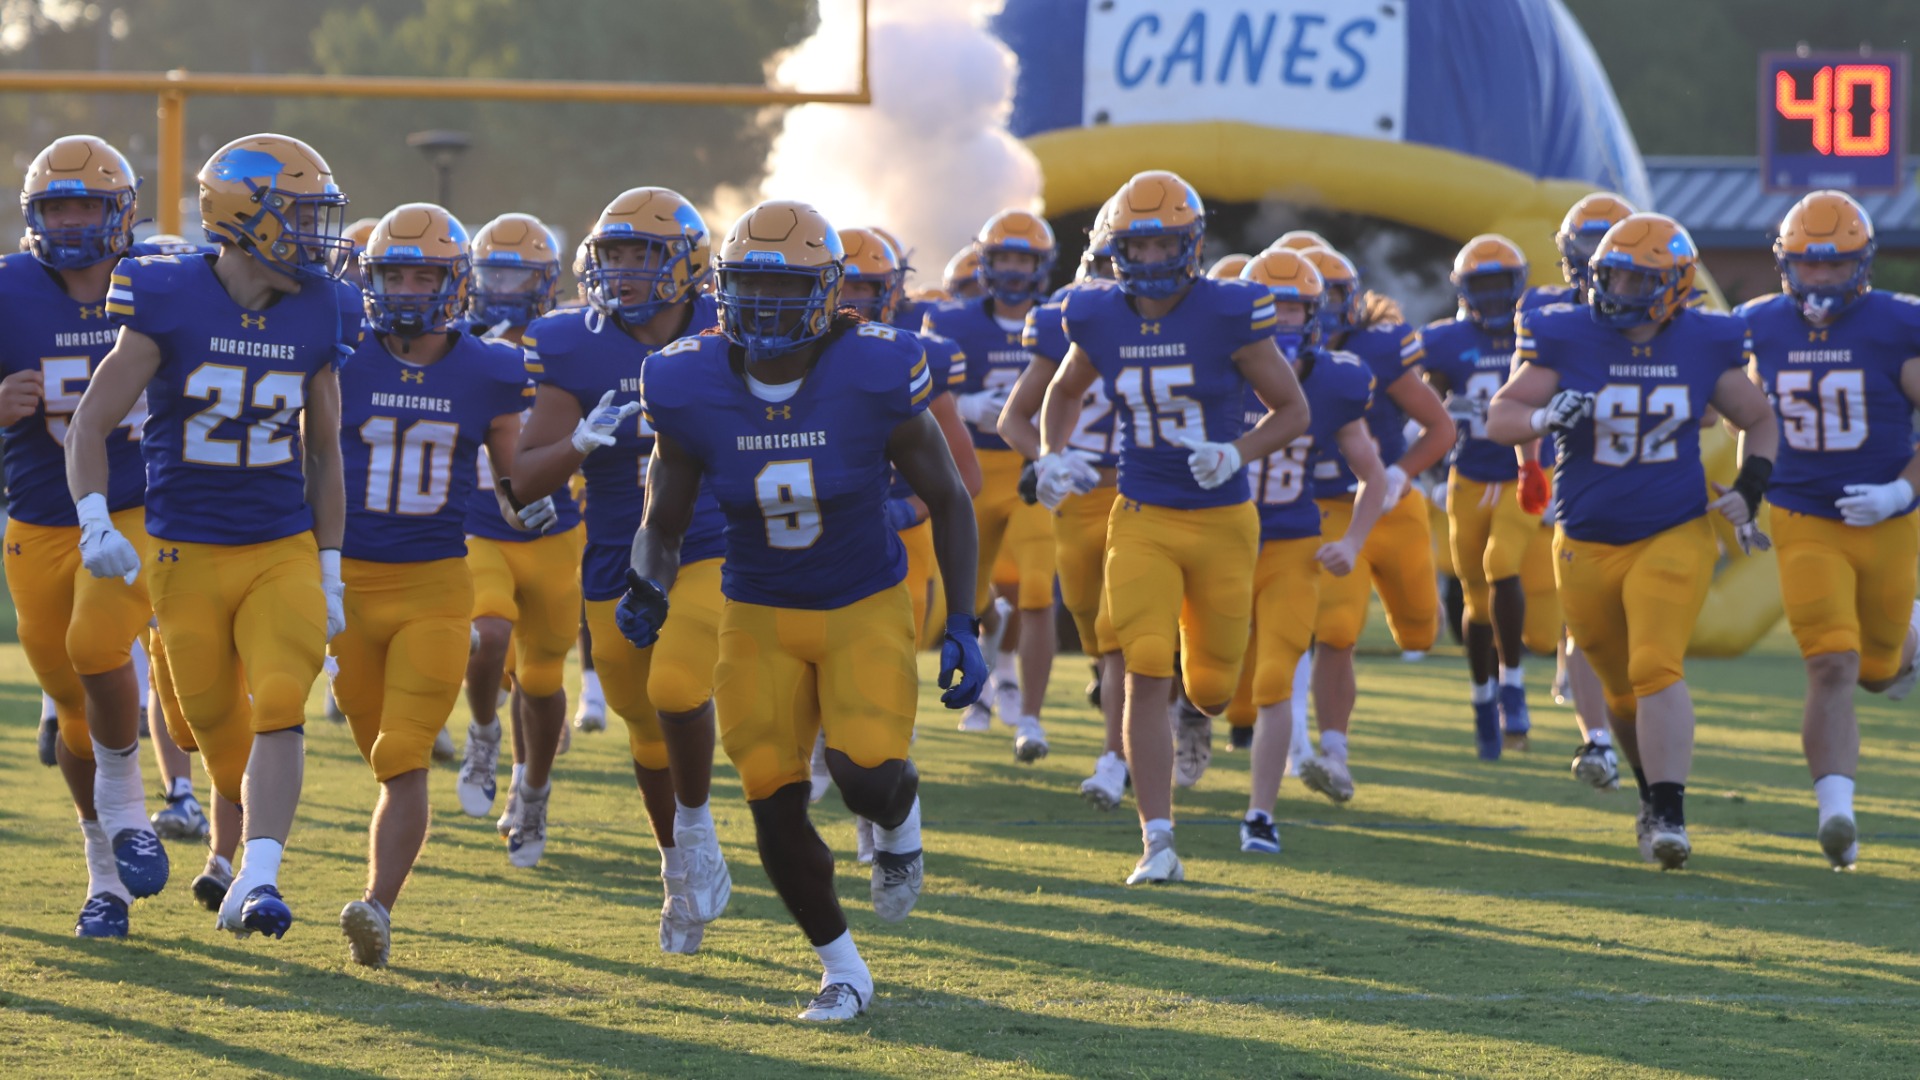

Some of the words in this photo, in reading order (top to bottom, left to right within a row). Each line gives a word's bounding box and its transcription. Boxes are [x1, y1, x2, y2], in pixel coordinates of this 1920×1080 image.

[1114, 10, 1378, 90] CANES
[1776, 65, 1891, 156] 40
[752, 252, 776, 263] WREN
[55, 329, 119, 347] HURRICAN
[210, 337, 295, 360] HURRICANES
[1119, 343, 1187, 359] HURRICANES
[1788, 349, 1852, 363] HURRICANES
[1609, 364, 1679, 378] HURRICANES
[183, 362, 305, 467] 22
[371, 392, 451, 413] HURRICANES
[1115, 364, 1207, 448] 15
[1594, 383, 1690, 467] 62
[1776, 370, 1868, 451] 50
[359, 415, 459, 516] 10
[737, 431, 826, 451] HURRICANES
[754, 458, 824, 550] 9
